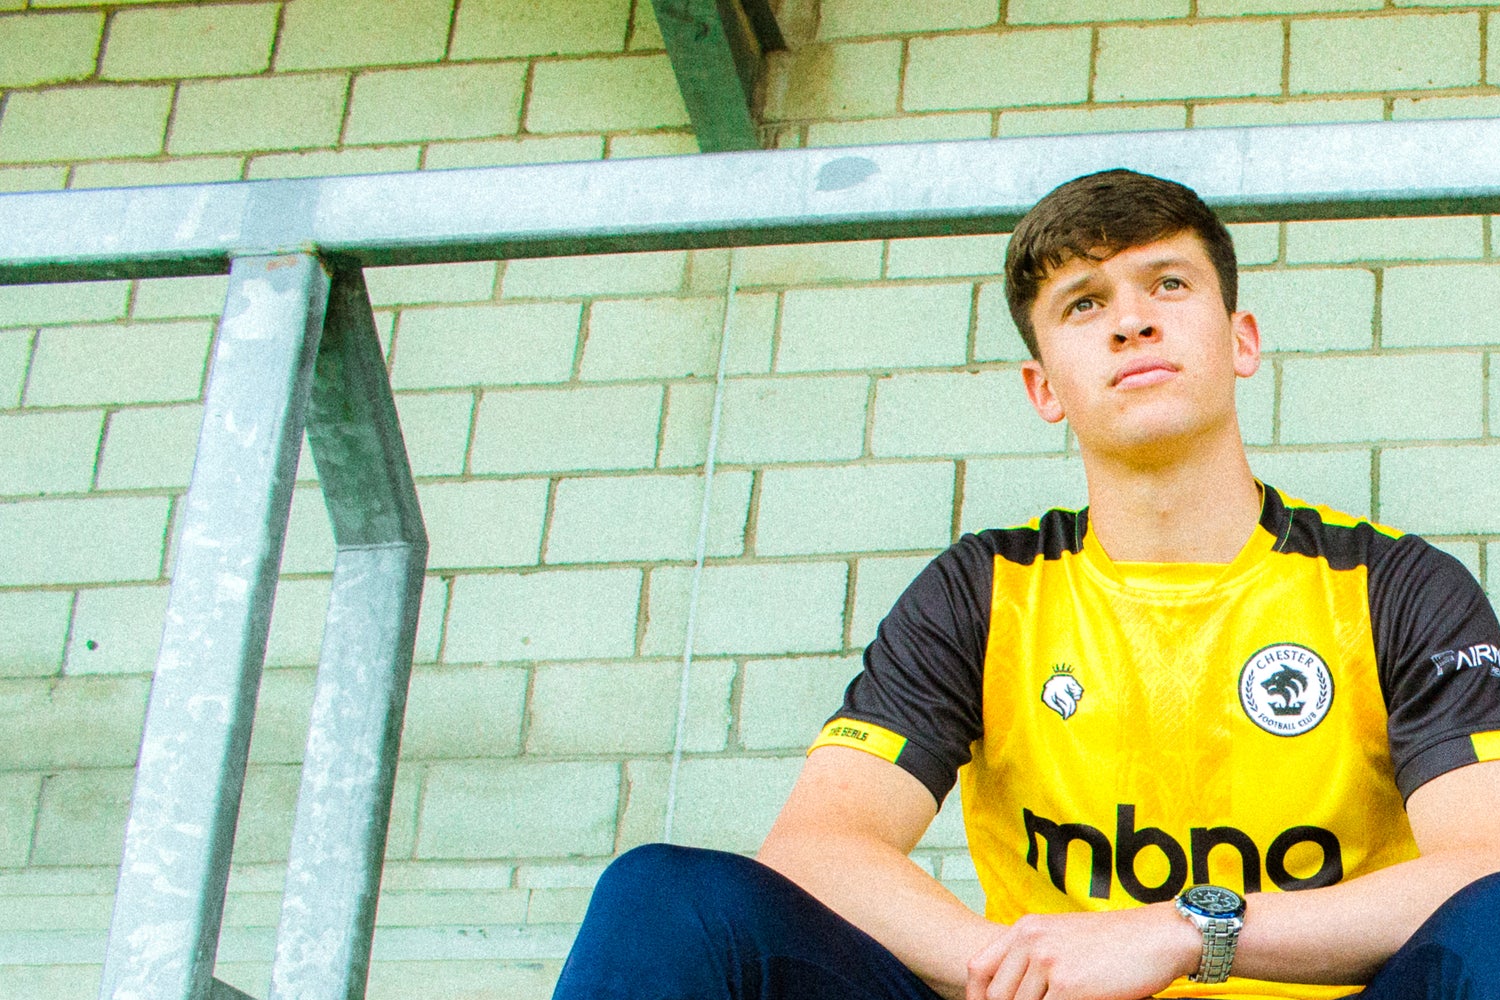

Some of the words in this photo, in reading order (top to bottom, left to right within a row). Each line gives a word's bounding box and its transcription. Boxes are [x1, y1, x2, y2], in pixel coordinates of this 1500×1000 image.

[1256, 649, 1314, 669] CHESTER
[1258, 713, 1296, 730] FOOTBALL
[1298, 712, 1317, 727] CLUB
